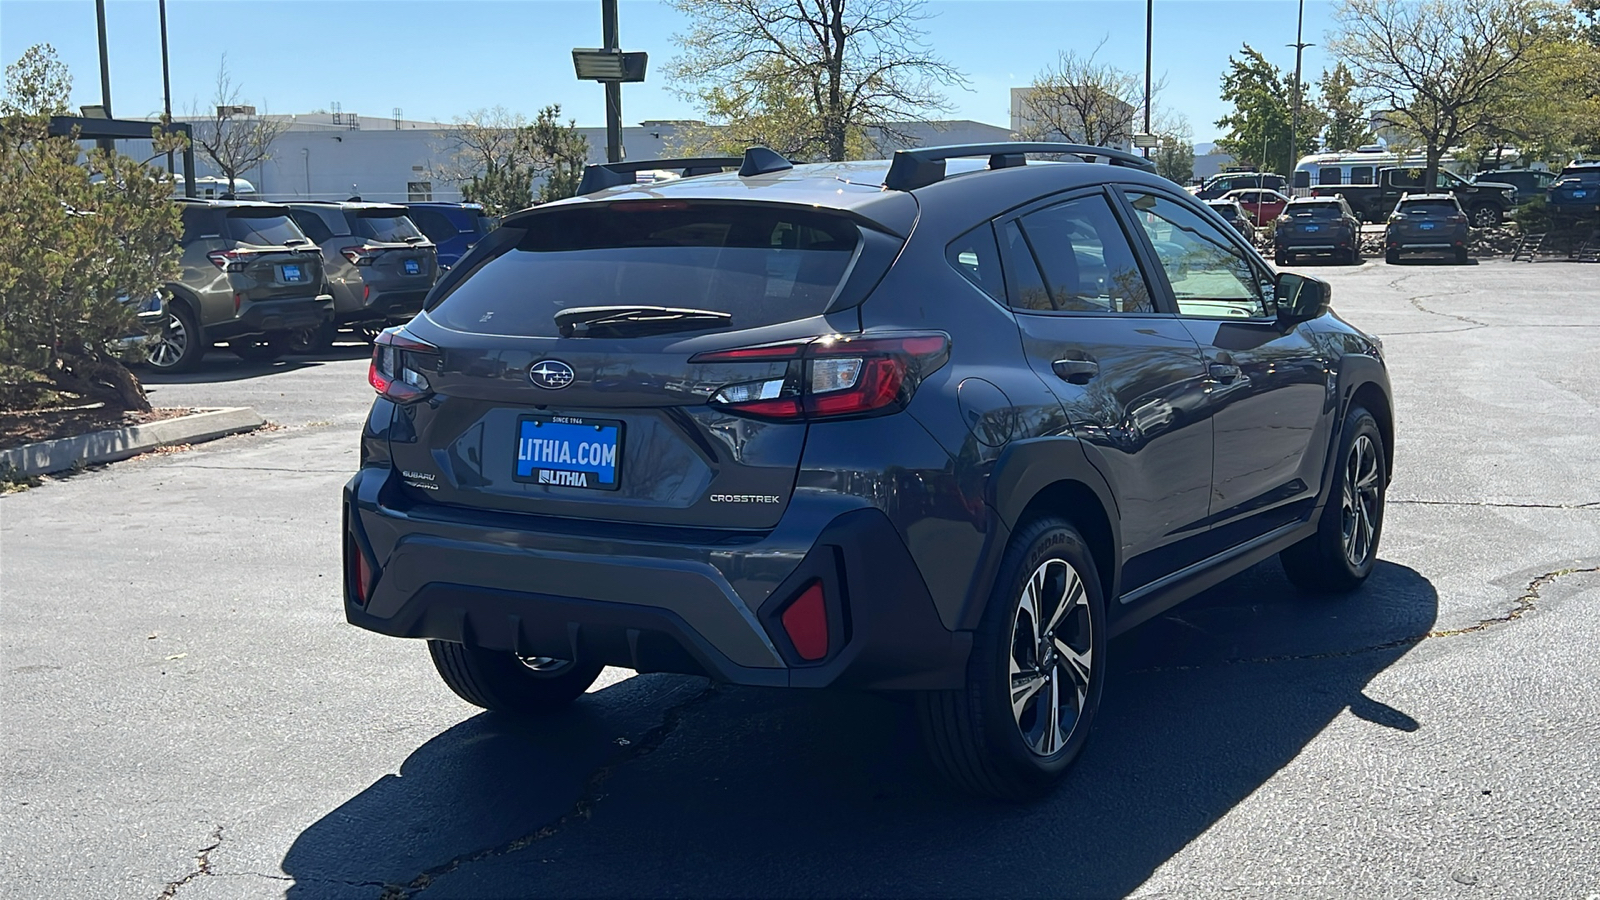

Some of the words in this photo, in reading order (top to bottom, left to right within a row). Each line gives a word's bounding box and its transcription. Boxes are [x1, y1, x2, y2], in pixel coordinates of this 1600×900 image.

[552, 416, 569, 424] SINCE
[518, 438, 616, 467] LITHIA.COM
[402, 470, 436, 481] SUBARU
[549, 469, 588, 487] LITHIA
[710, 494, 780, 504] CROSSTREK
